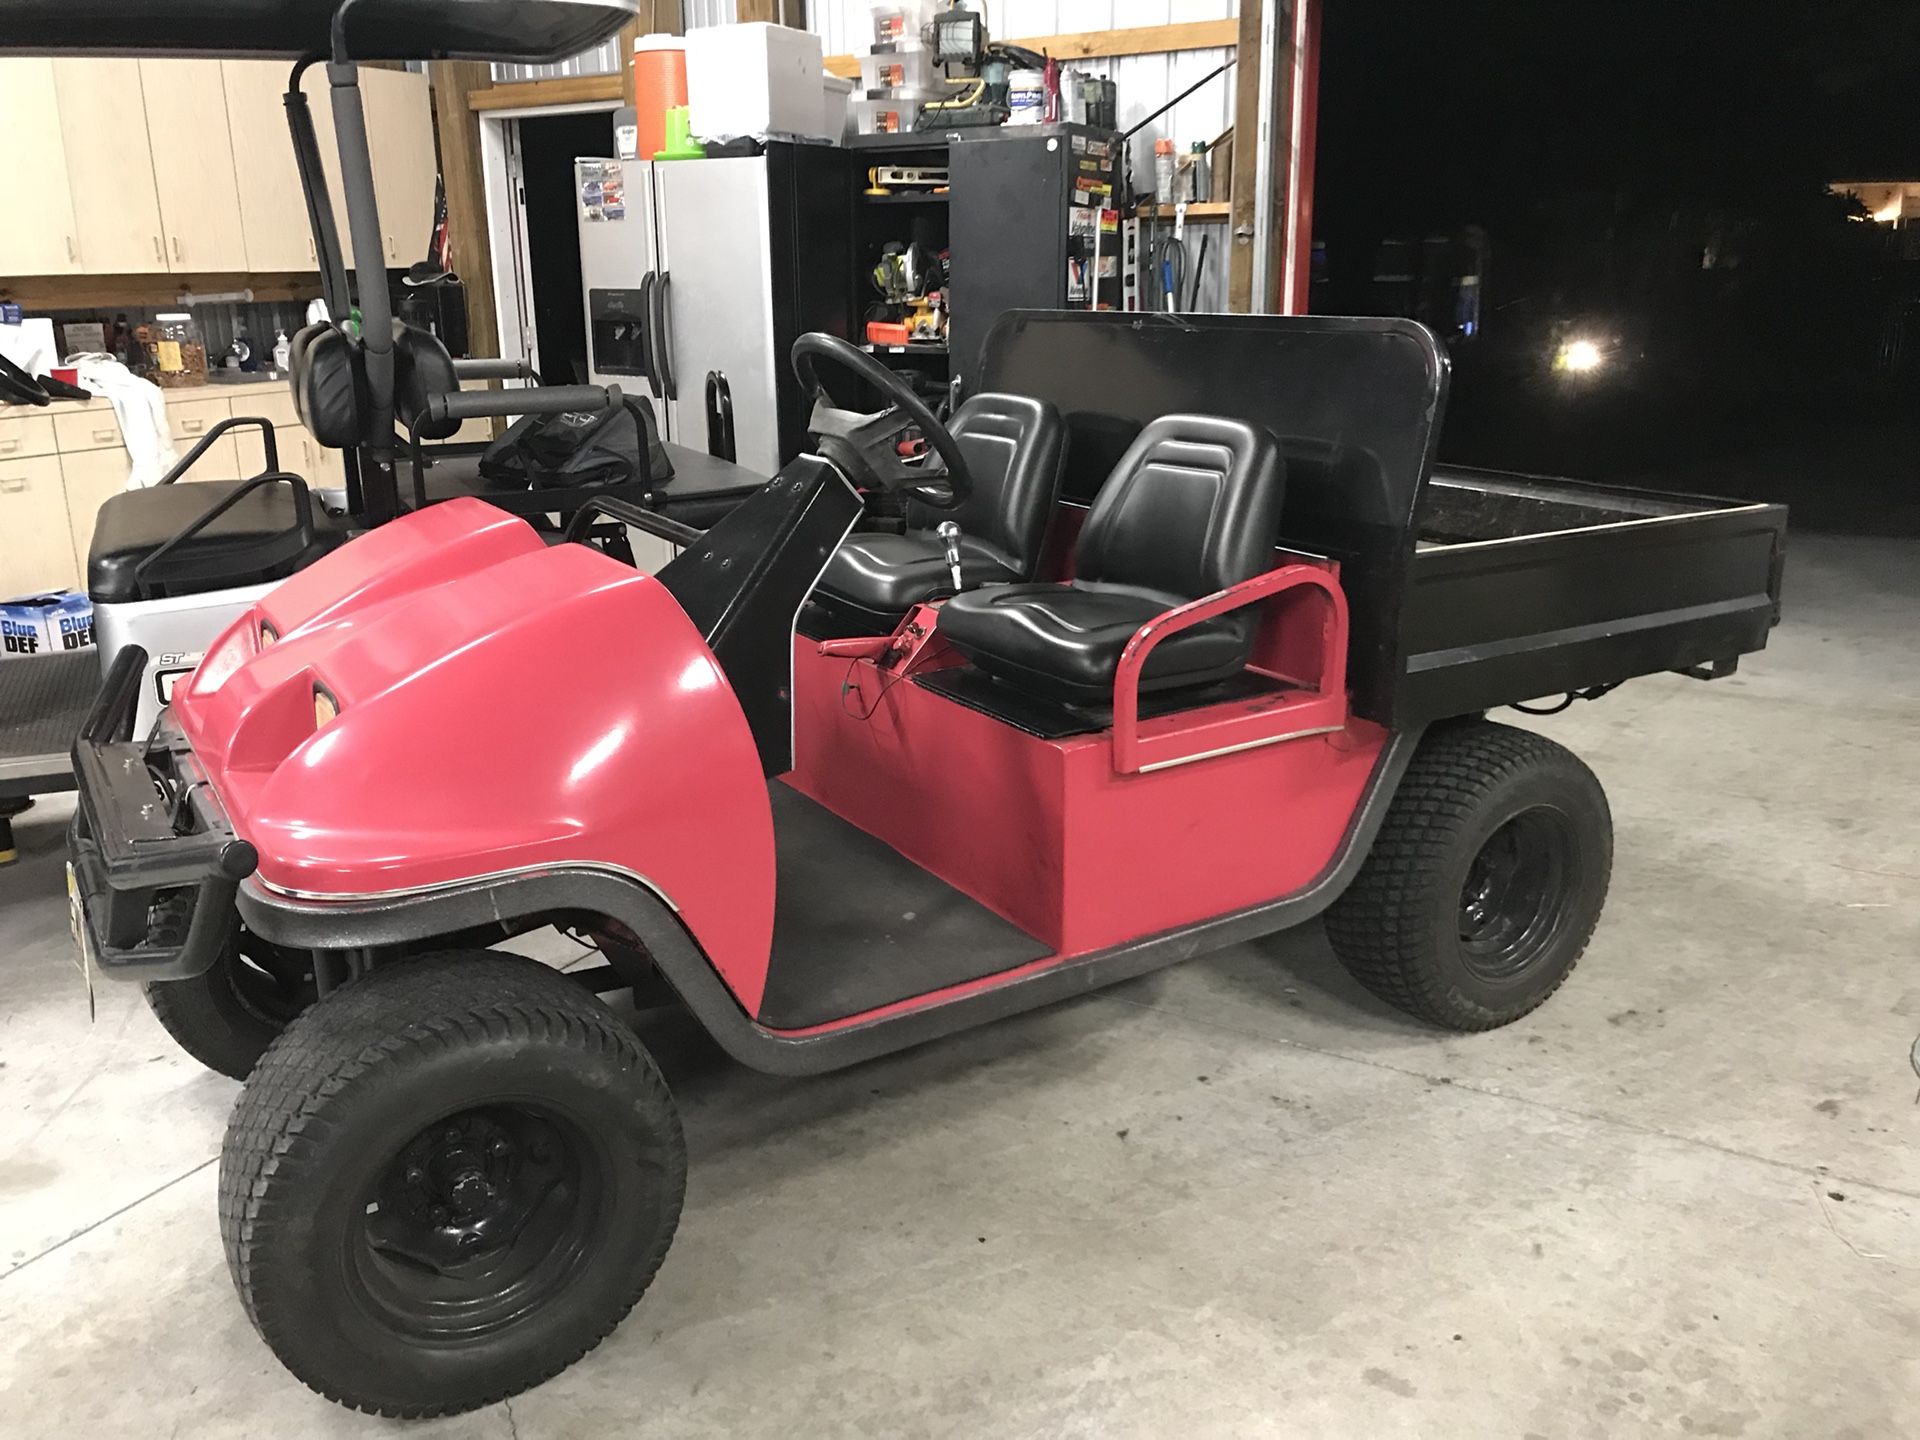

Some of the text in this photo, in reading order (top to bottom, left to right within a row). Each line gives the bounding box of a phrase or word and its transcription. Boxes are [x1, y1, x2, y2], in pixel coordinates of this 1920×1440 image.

[1, 620, 38, 638] Blue
[4, 635, 38, 654] DEF
[160, 651, 185, 665] ST
